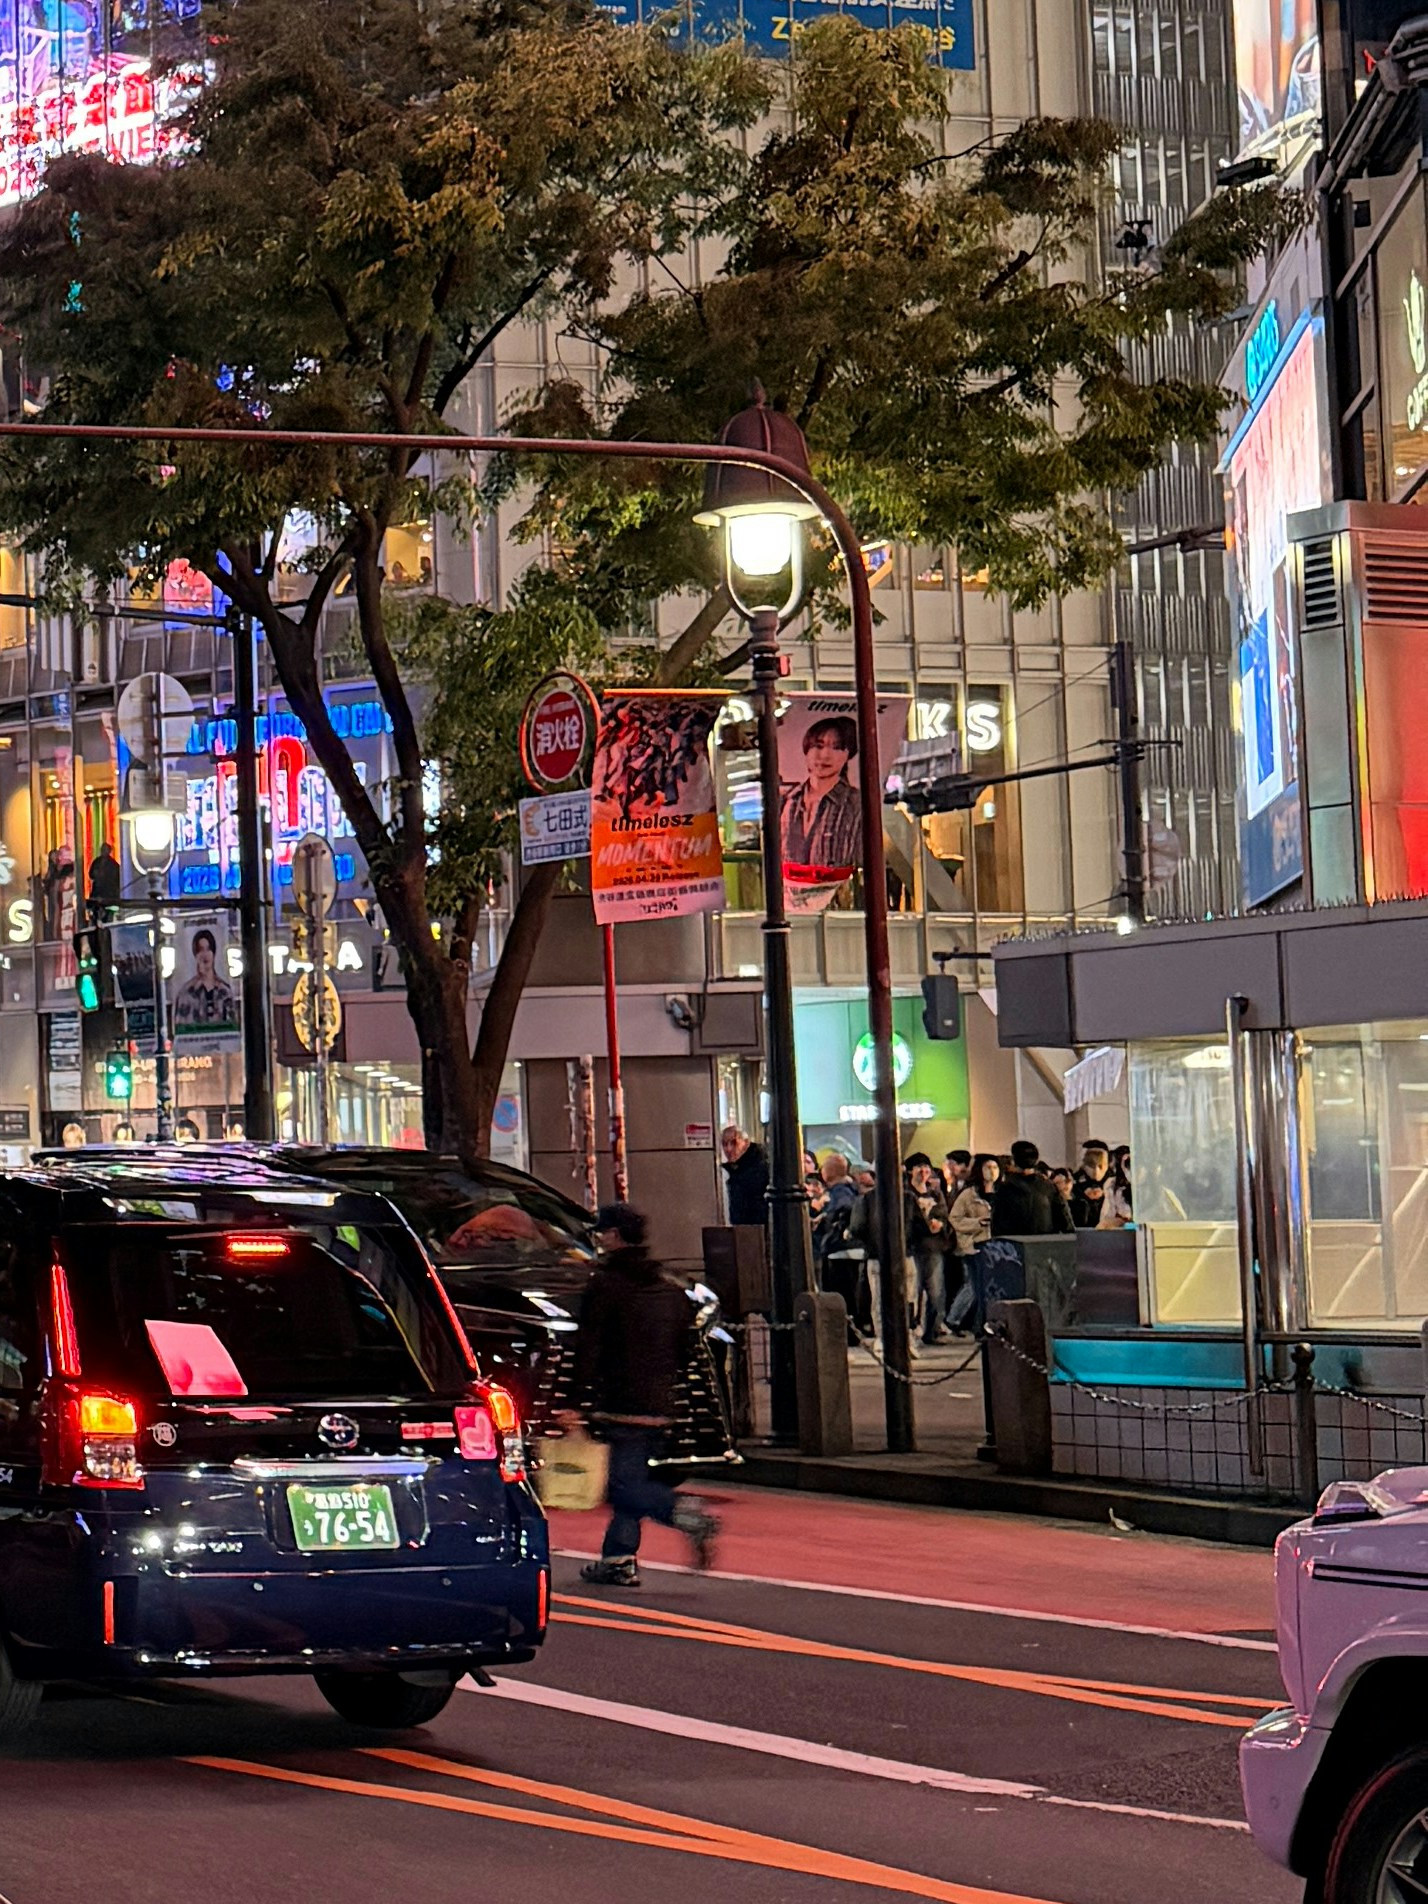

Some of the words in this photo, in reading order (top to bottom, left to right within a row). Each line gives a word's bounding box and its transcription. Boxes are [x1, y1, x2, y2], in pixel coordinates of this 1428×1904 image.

[535, 714, 580, 757] 消火栓
[544, 806, 589, 834] 七田式
[314, 1510, 391, 1544] 76-54
